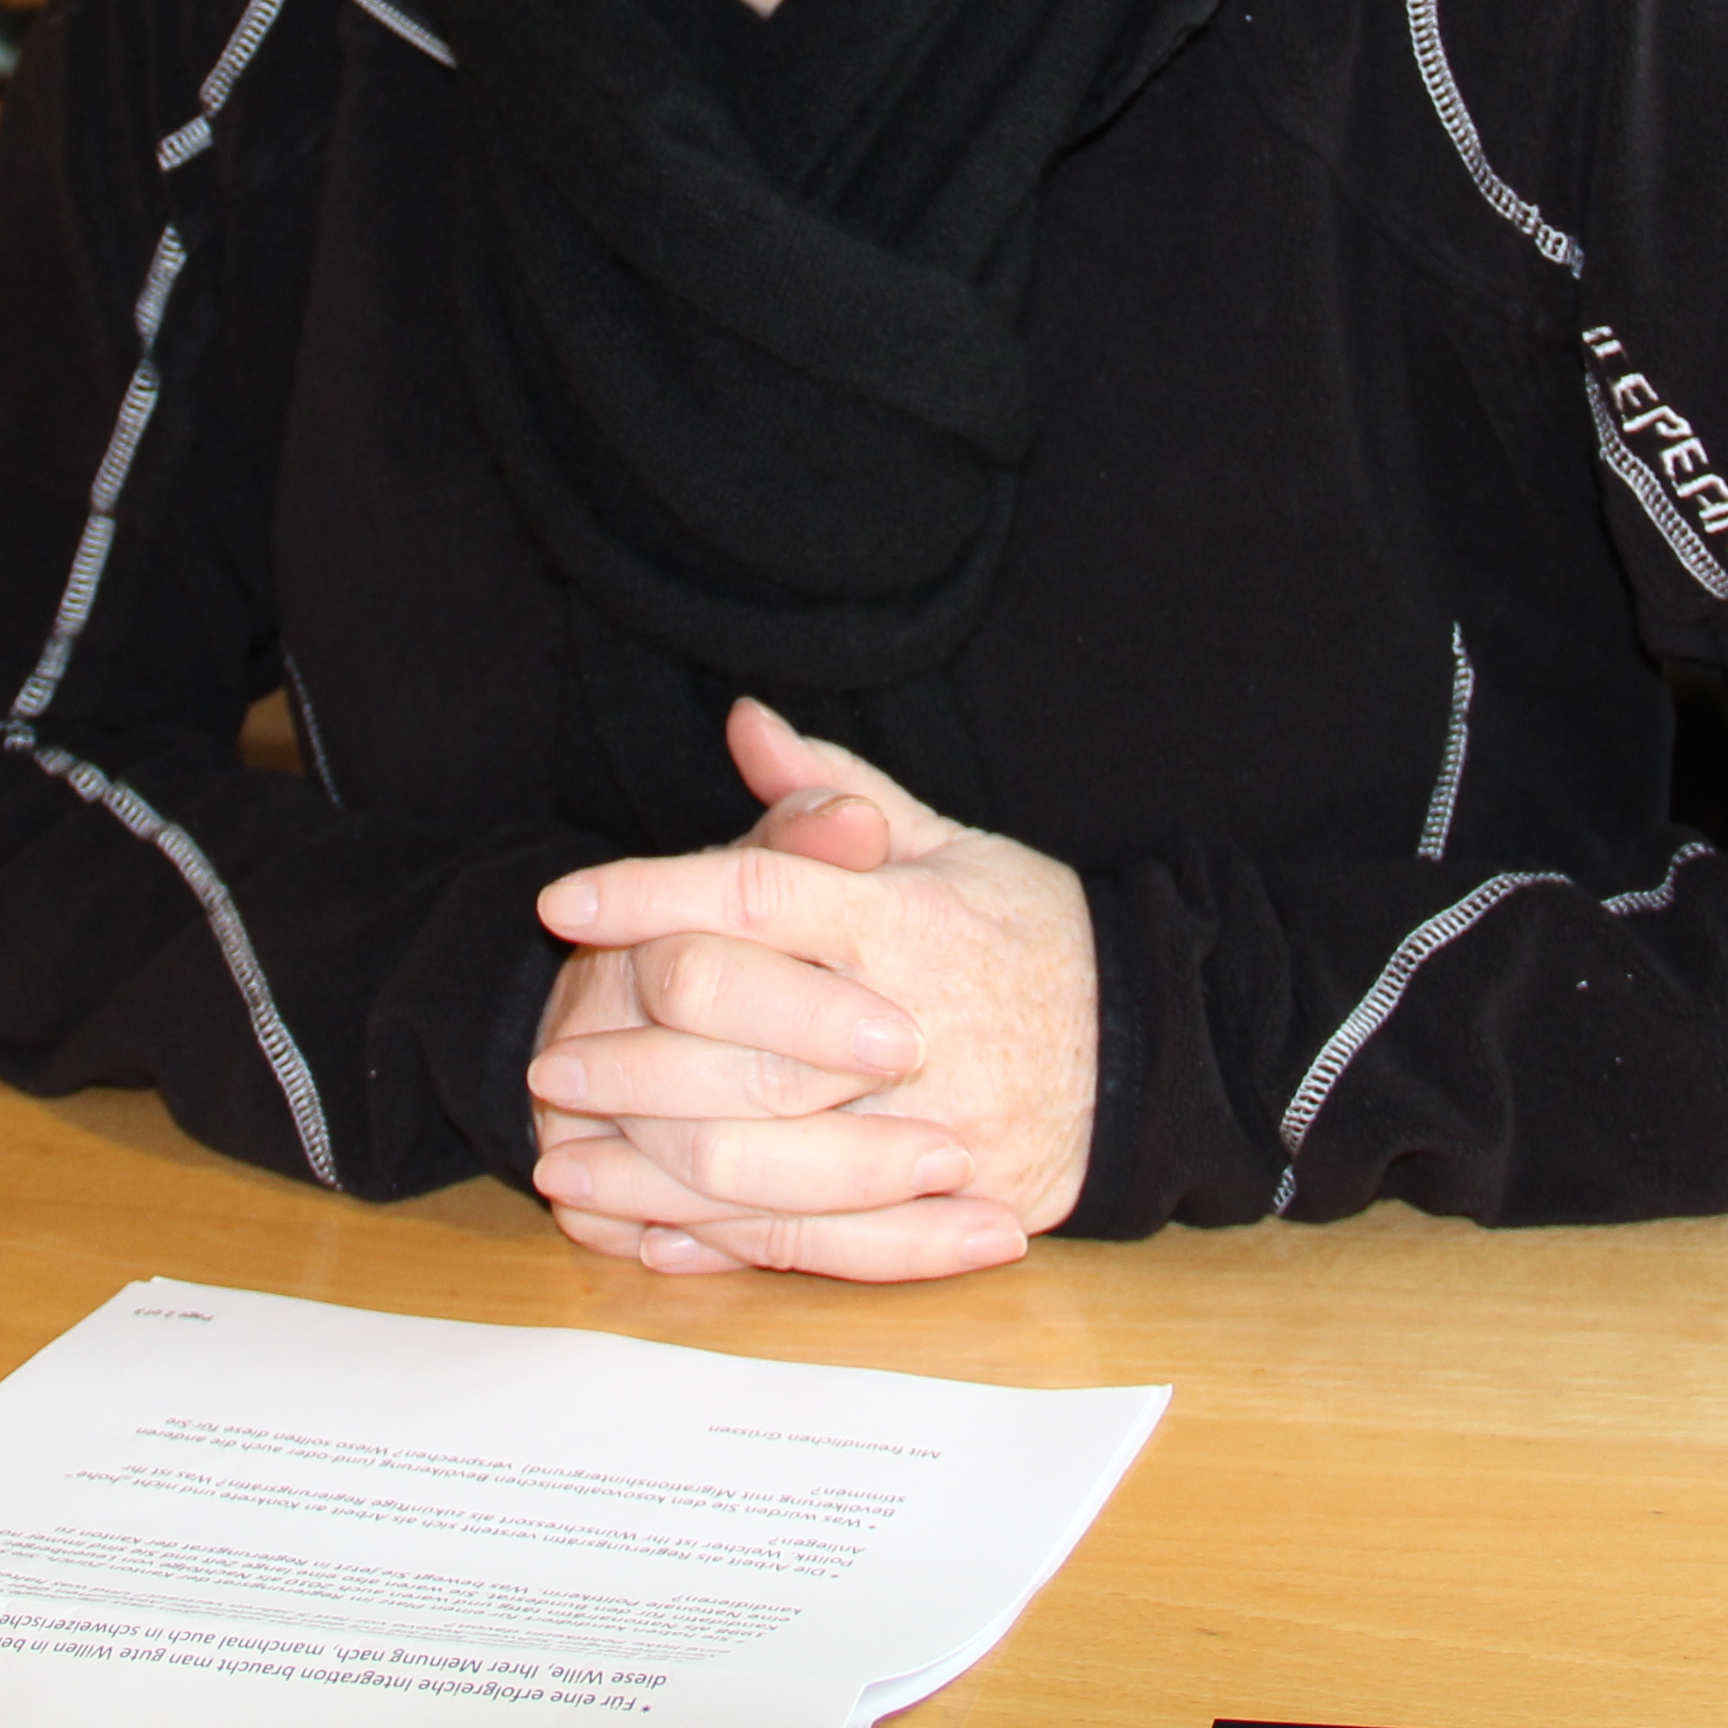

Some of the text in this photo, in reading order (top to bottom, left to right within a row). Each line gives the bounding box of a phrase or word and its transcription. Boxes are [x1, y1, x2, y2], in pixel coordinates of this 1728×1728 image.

[135, 1427, 206, 1445] anderen
[210, 1437, 237, 1450] die
[708, 1423, 942, 1461] Mit freundlichen Grüssen
[241, 1441, 283, 1456] auch
[122, 1463, 148, 1475] Ihr
[151, 1467, 173, 1478] ist
[165, 1417, 896, 1519] Bevölkerung mit Migrationshintergrund) versprechen? Wieso sollten diese für Sie
[379, 1459, 490, 1483] Bevölkerung
[132, 1478, 177, 1492] nicht
[177, 1471, 212, 1485] Was
[178, 1484, 216, 1498] und
[215, 1476, 366, 1507] Regierungsrätin?
[494, 1474, 667, 1505] kosovoalbanischen
[810, 1485, 906, 1506] stimmen?
[220, 1491, 300, 1510] Konkrete
[305, 1503, 327, 1513] an
[671, 1496, 707, 1510] den
[711, 1501, 740, 1514] Sie
[331, 1506, 389, 1523] Arbeit
[392, 1515, 417, 1527] als
[470, 1512, 495, 1524] als
[744, 1505, 816, 1524] würden
[823, 1514, 861, 1529] Was
[422, 1519, 458, 1531] sich
[462, 1524, 536, 1541] versteht
[25, 1533, 85, 1547] immer
[543, 1533, 691, 1561] Regierungsrätin
[644, 1533, 670, 1546] Ihr
[675, 1537, 698, 1549] ist
[768, 1533, 865, 1557] Anliegen?
[87, 1542, 128, 1554] sind
[131, 1548, 159, 1558] Sie
[702, 1541, 781, 1559] Welcher
[160, 1551, 198, 1563] und
[202, 1556, 238, 1568] Zeit
[697, 1553, 723, 1565] als
[728, 1557, 790, 1573] Arbeit
[791, 1551, 854, 1568] Politik.
[54, 1526, 790, 1624] eine Nationale Politikerin. Was bewegt Sie jetzt in Regierungsrat der Kanton zu
[242, 1561, 292, 1575] lange
[296, 1569, 337, 1580] eine
[794, 1565, 826, 1577] Die
[342, 1575, 380, 1586] also
[385, 1580, 443, 1593] waren
[449, 1588, 479, 1599] Sie
[594, 1605, 631, 1616] den
[671, 1593, 802, 1617] kandidieren?
[635, 1609, 665, 1620] für
[672, 1613, 779, 1633] Kandidatin
[144, 1626, 164, 1642] in
[168, 1628, 215, 1649] auch
[30, 1639, 50, 1655] in
[53, 1639, 113, 1663] Willen
[120, 1643, 166, 1666] gute
[217, 1632, 326, 1663] manchmal
[168, 1652, 213, 1669] man
[332, 1643, 385, 1668] nach,
[390, 1647, 483, 1676] Meinung
[217, 1657, 296, 1683] braucht
[488, 1659, 540, 1681] Ihrer
[547, 1662, 604, 1687] Wille,
[300, 1662, 413, 1695] Integration
[612, 1669, 666, 1691] diese
[418, 1673, 544, 1708] erfolgreiche
[550, 1689, 596, 1709] eine
[600, 1693, 636, 1712] Für
